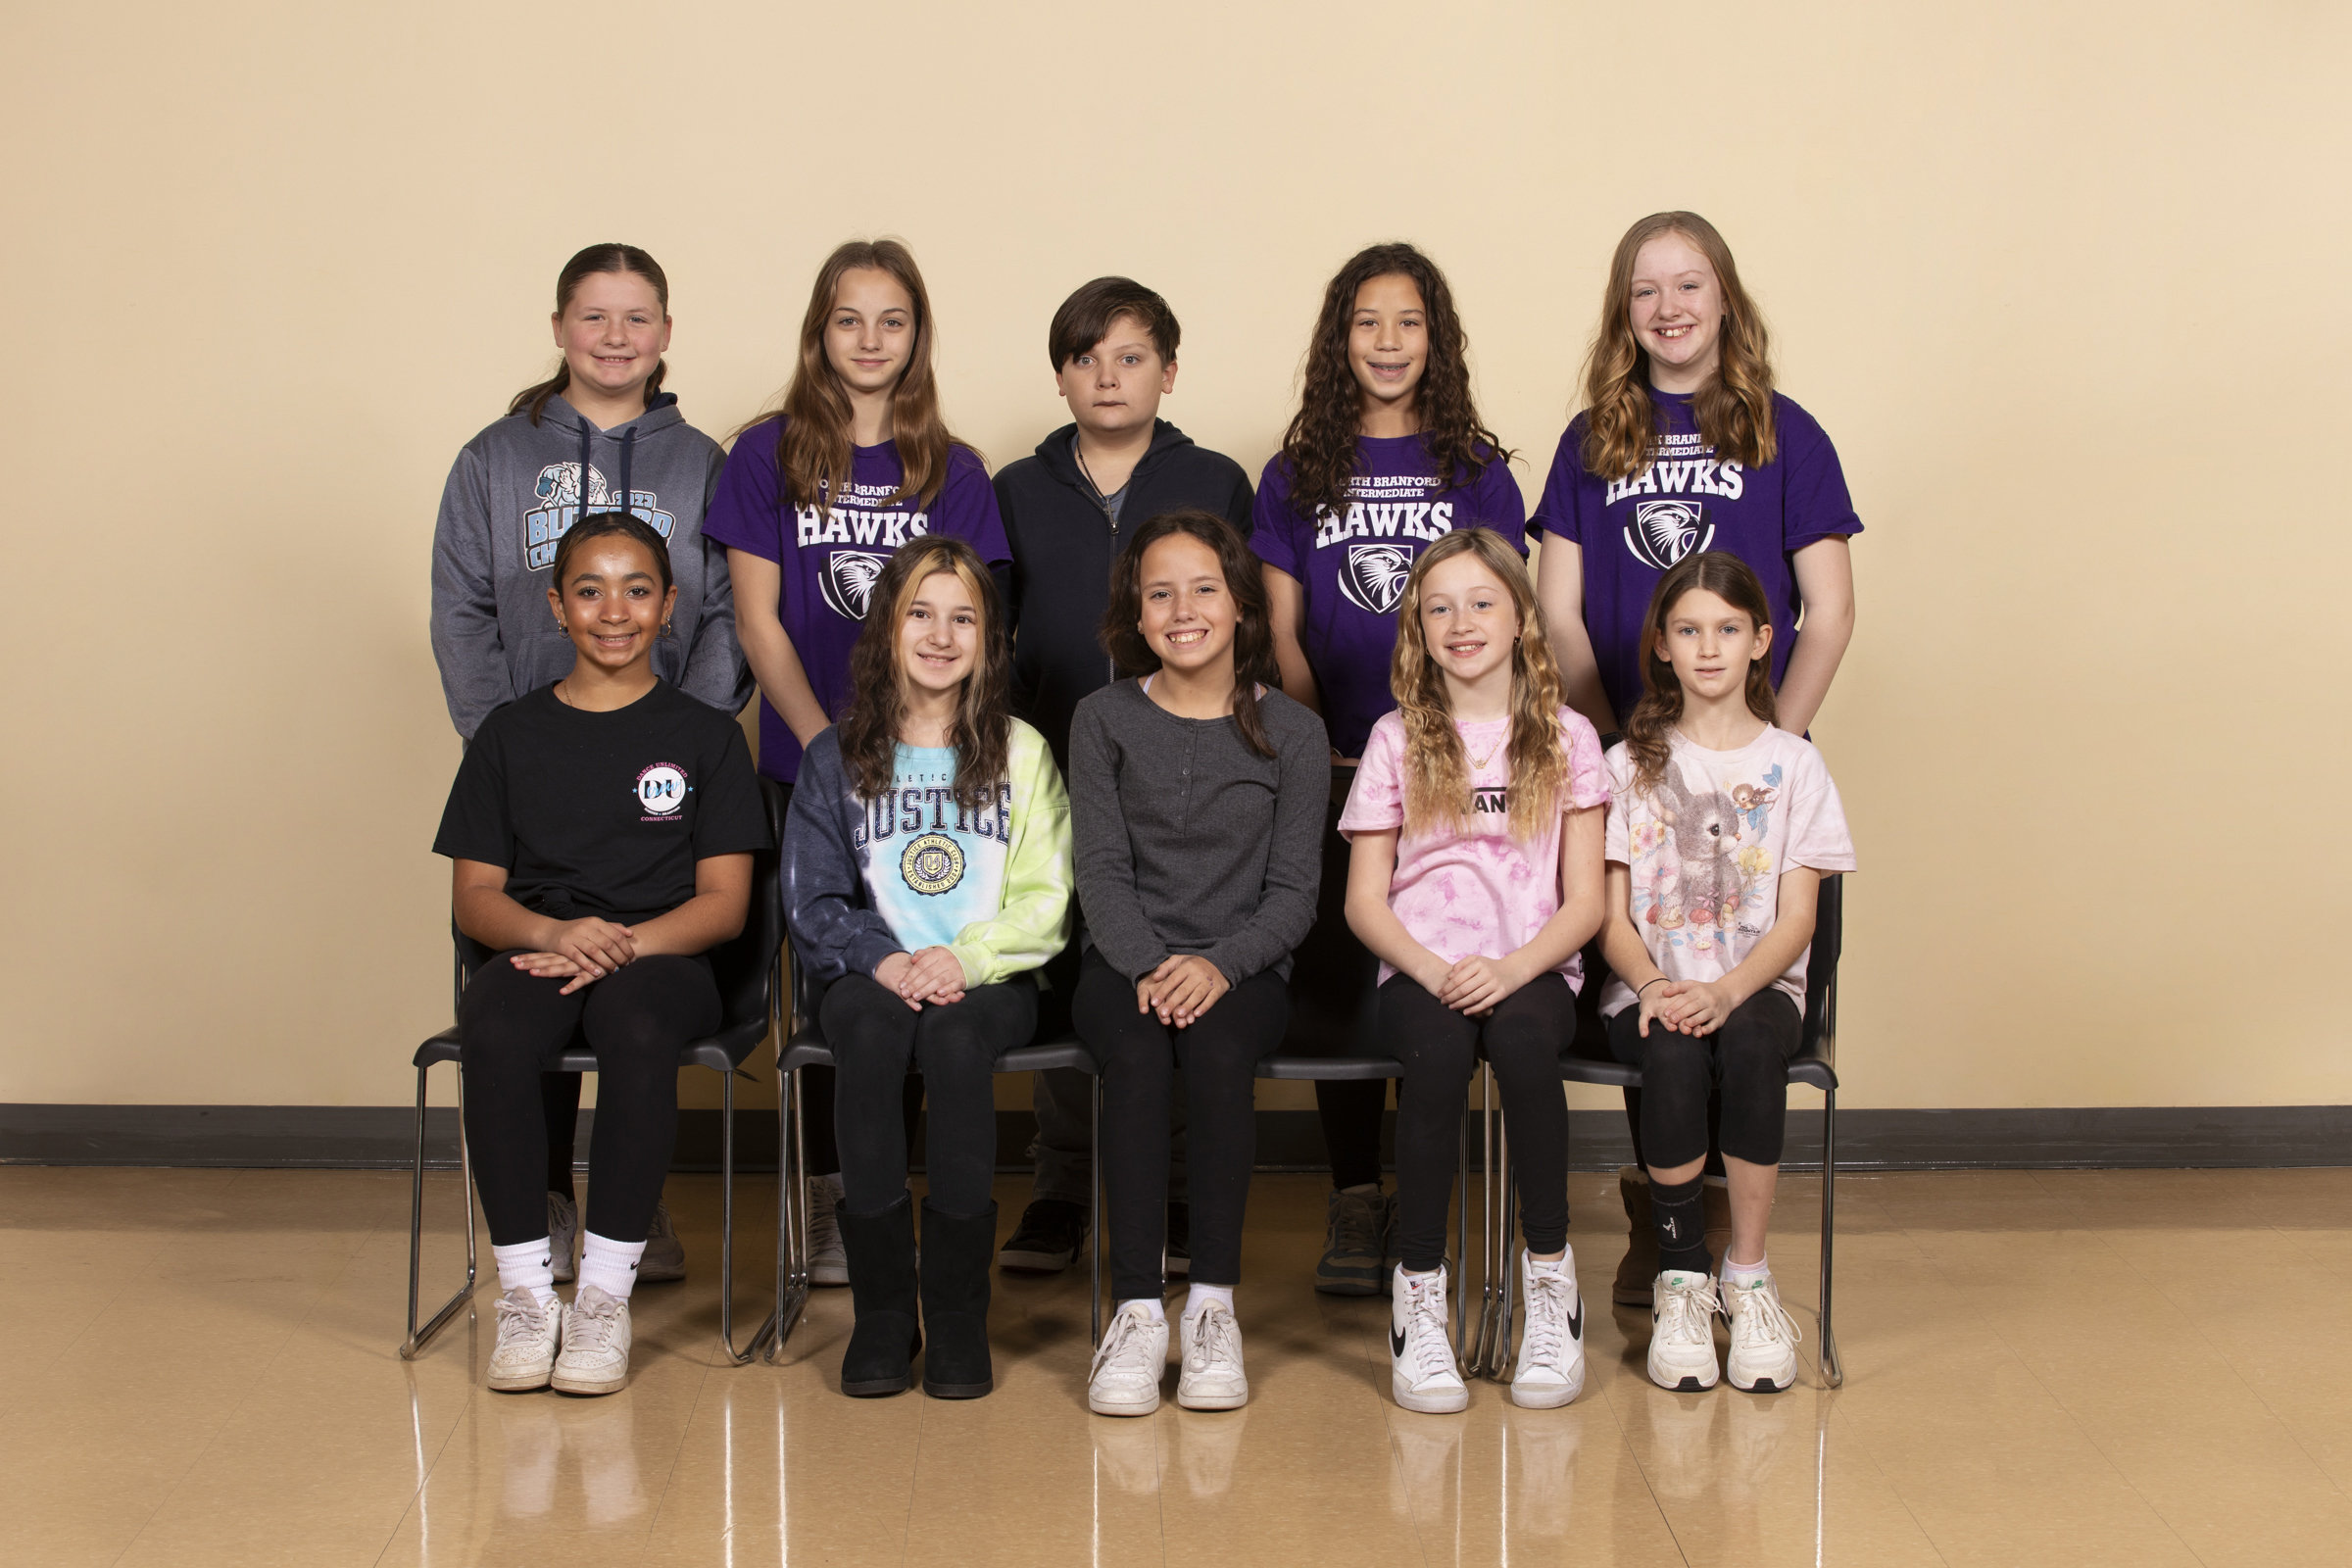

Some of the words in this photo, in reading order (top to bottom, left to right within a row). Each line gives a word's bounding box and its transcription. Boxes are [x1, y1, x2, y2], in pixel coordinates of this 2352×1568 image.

[1373, 475, 1442, 487] BRANFORD
[1605, 458, 1743, 508] HAWKS
[795, 501, 929, 549] HAWKS
[1315, 501, 1453, 549] HAWKS
[636, 763, 655, 781] DANCE
[656, 761, 688, 778] UNLIMITED
[1473, 794, 1506, 813] AN
[854, 782, 1012, 851] JUSTICE
[906, 844, 921, 864] JUSTICE
[923, 839, 952, 850] ATHLETIC
[906, 870, 946, 889] ESTABLISHED
